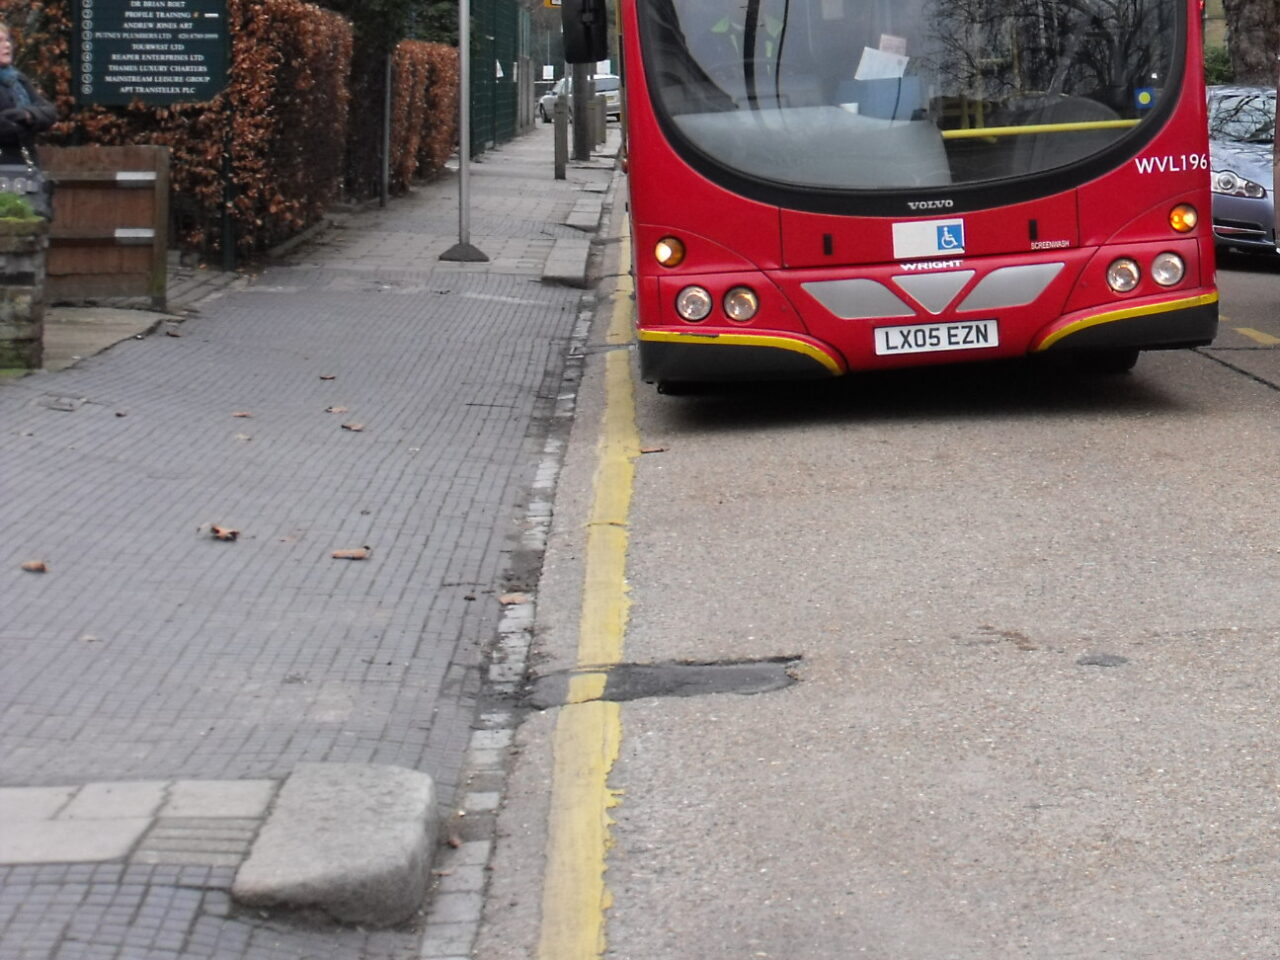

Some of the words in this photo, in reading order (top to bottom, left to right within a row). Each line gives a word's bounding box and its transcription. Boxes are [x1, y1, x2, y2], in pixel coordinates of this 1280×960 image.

[143, 0, 166, 8] BRIAN
[156, 11, 192, 19] TRAINING
[1134, 153, 1208, 174] WVL196
[907, 199, 954, 210] VOLVO
[1030, 239, 1070, 250] SCREENWASH
[900, 259, 965, 271] WRIGHT
[885, 327, 941, 351] LX05
[947, 323, 989, 347] EZN
